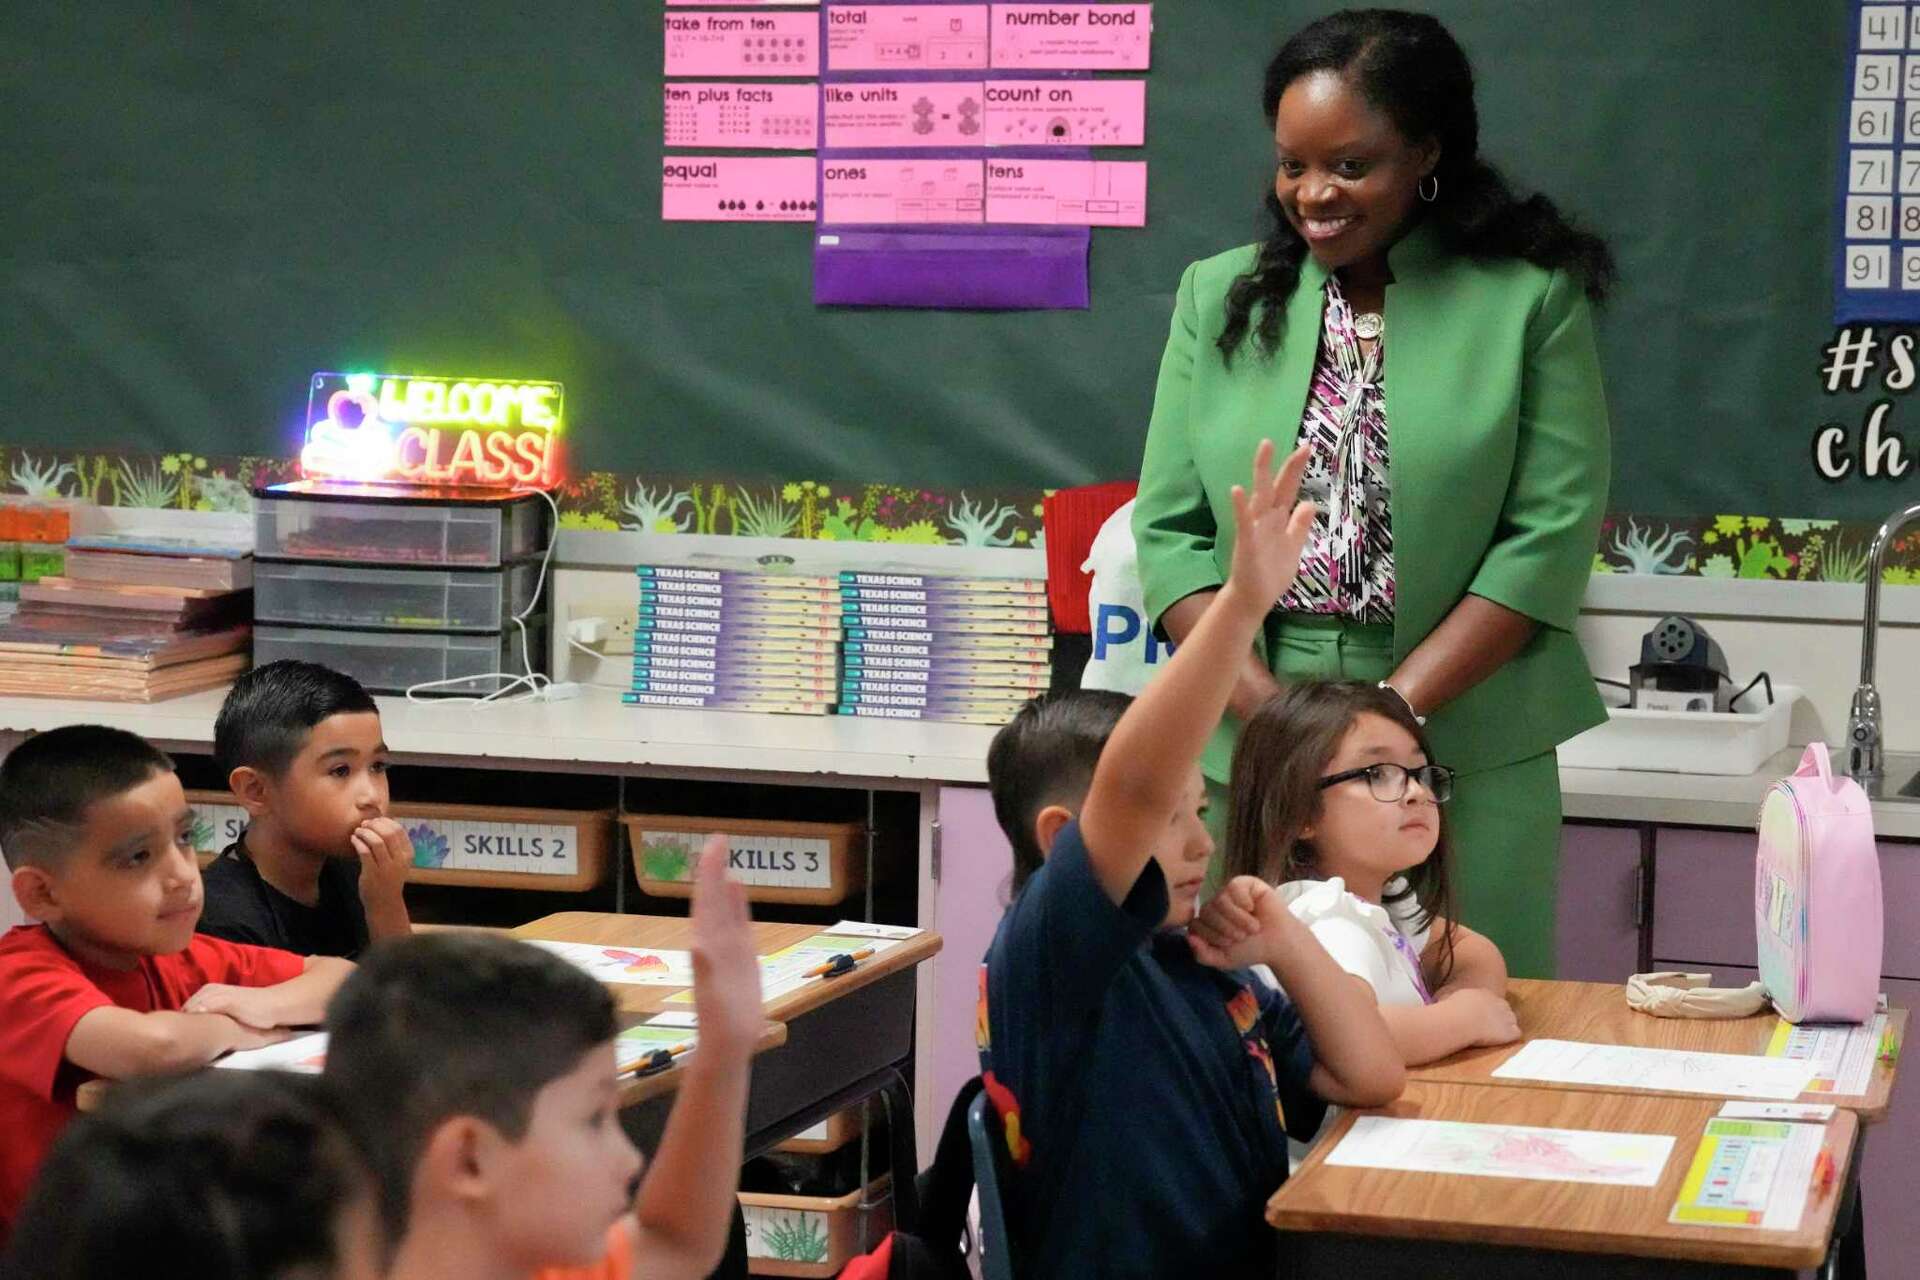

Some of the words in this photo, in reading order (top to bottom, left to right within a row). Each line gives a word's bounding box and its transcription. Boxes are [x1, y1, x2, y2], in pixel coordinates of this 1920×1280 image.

[665, 18, 700, 30] take
[707, 17, 743, 30] from
[751, 18, 775, 30] ten
[830, 11, 867, 24] total
[1006, 9, 1080, 26] number
[1088, 10, 1135, 26] bond
[1869, 15, 1898, 40] 41
[1862, 66, 1891, 91] 51
[665, 89, 691, 101] ten
[698, 89, 729, 104] plus
[737, 88, 773, 102] facts
[826, 89, 854, 102] like
[860, 89, 898, 102] units
[987, 87, 1041, 101] count
[1049, 89, 1072, 101] on
[1857, 111, 1887, 136] 61
[663, 163, 717, 179] equal
[825, 167, 867, 180] ones
[989, 165, 1024, 179] tens
[1857, 161, 1885, 186] 71
[1856, 205, 1886, 231] 81
[1852, 255, 1882, 280] 91
[655, 568, 683, 578] TEXAS
[685, 570, 720, 580] SCIENCE
[856, 575, 885, 584] TEXAS
[886, 576, 922, 586] SCIENCE
[657, 581, 685, 591] TEXAS
[686, 583, 722, 593] SCIENCE
[658, 594, 686, 604] TEXAS
[687, 596, 722, 607] SCIENCE
[860, 589, 888, 599] TEXAS
[890, 590, 926, 600] SCIENCE
[655, 607, 683, 617] TEXAS
[684, 609, 720, 619] SCIENCE
[860, 603, 889, 613] TEXAS
[890, 605, 926, 614] SCIENCE
[655, 620, 684, 629] TEXAS
[685, 622, 720, 632] SCIENCE
[861, 616, 889, 626] TEXAS
[891, 618, 927, 628] SCIENCE
[652, 632, 680, 643] TEXAS
[681, 634, 716, 644] SCIENCE
[867, 630, 895, 639] TEXAS
[896, 632, 932, 641] SCIENCE
[651, 645, 679, 655] TEXAS
[680, 646, 715, 657] SCIENCE
[863, 644, 891, 653] TEXAS
[893, 645, 928, 655] SCIENCE
[651, 657, 679, 667] TEXAS
[680, 659, 715, 669] SCIENCE
[864, 657, 893, 667] TEXAS
[895, 659, 930, 668] SCIENCE
[650, 670, 678, 680] TEXAS
[679, 672, 714, 682] SCIENCE
[863, 670, 891, 679] TEXAS
[893, 672, 928, 681] SCIENCE
[650, 683, 678, 692] TEXAS
[679, 684, 715, 694] SCIENCE
[861, 682, 889, 692] TEXAS
[890, 684, 926, 694] SCIENCE
[639, 695, 668, 705] TEXAS
[669, 696, 704, 706] SCIENCE
[861, 695, 889, 705] TEXAS
[891, 696, 926, 706] SCIENCE
[856, 707, 885, 716] TEXAS
[886, 708, 921, 718] SCIENCE
[464, 834, 543, 857] SKILLS
[552, 838, 566, 858] 2
[729, 849, 796, 871] KILLS
[804, 852, 819, 872] 3
